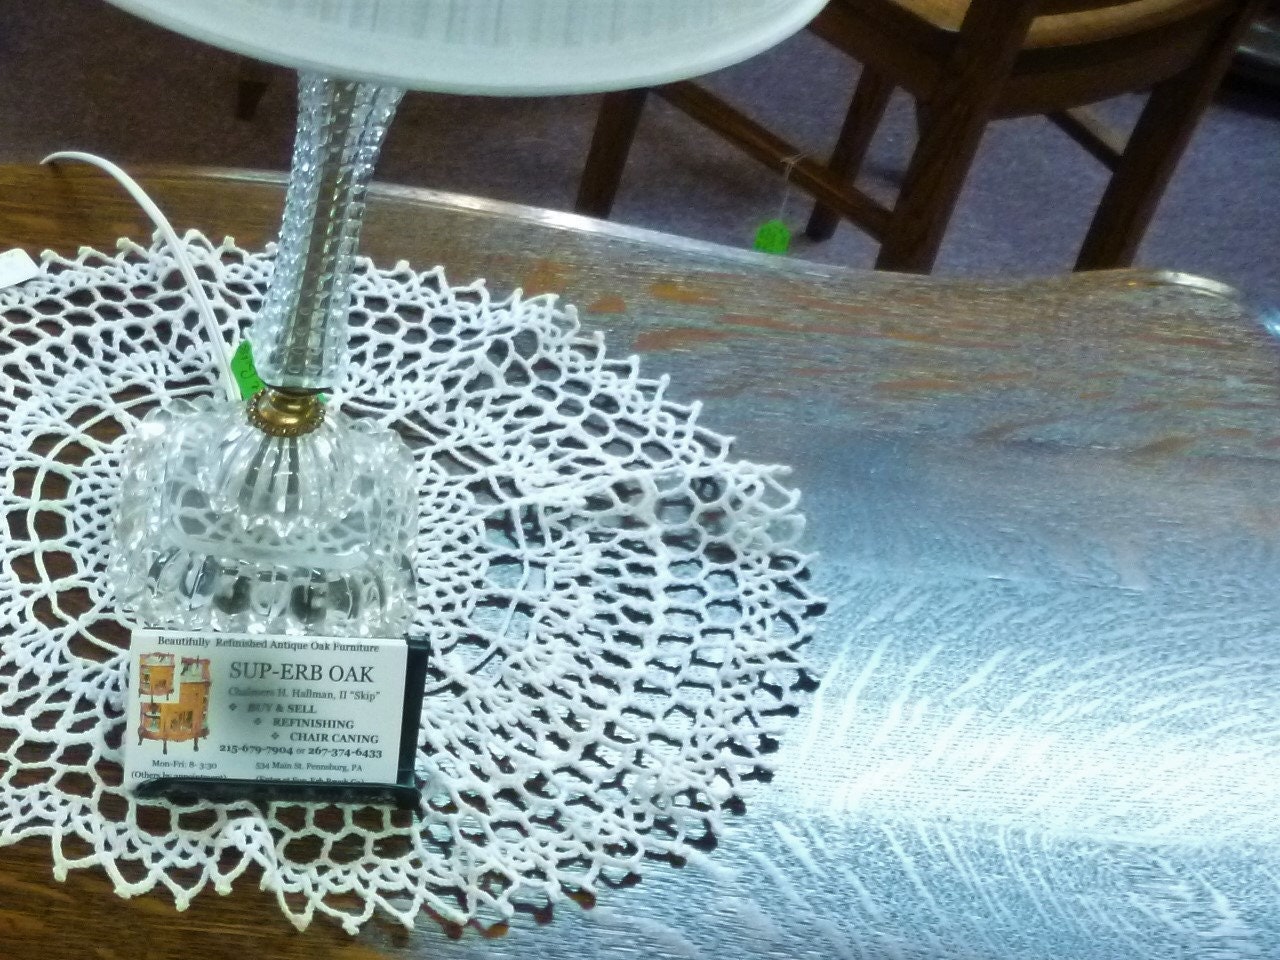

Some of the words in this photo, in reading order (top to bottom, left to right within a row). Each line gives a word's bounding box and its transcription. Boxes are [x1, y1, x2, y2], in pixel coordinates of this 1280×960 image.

[158, 636, 210, 647] Beautifully
[271, 641, 308, 652] Antique
[311, 642, 330, 651] Oak
[333, 643, 380, 653] Furniture
[229, 661, 323, 681] SUP-ERB
[329, 665, 375, 683] OAK
[287, 704, 317, 714] SELL
[273, 717, 355, 730] REFINISHING
[289, 732, 329, 743] CHAIR
[331, 733, 379, 744] CANING
[308, 746, 382, 759] 267-374-6433
[271, 762, 292, 770] Main
